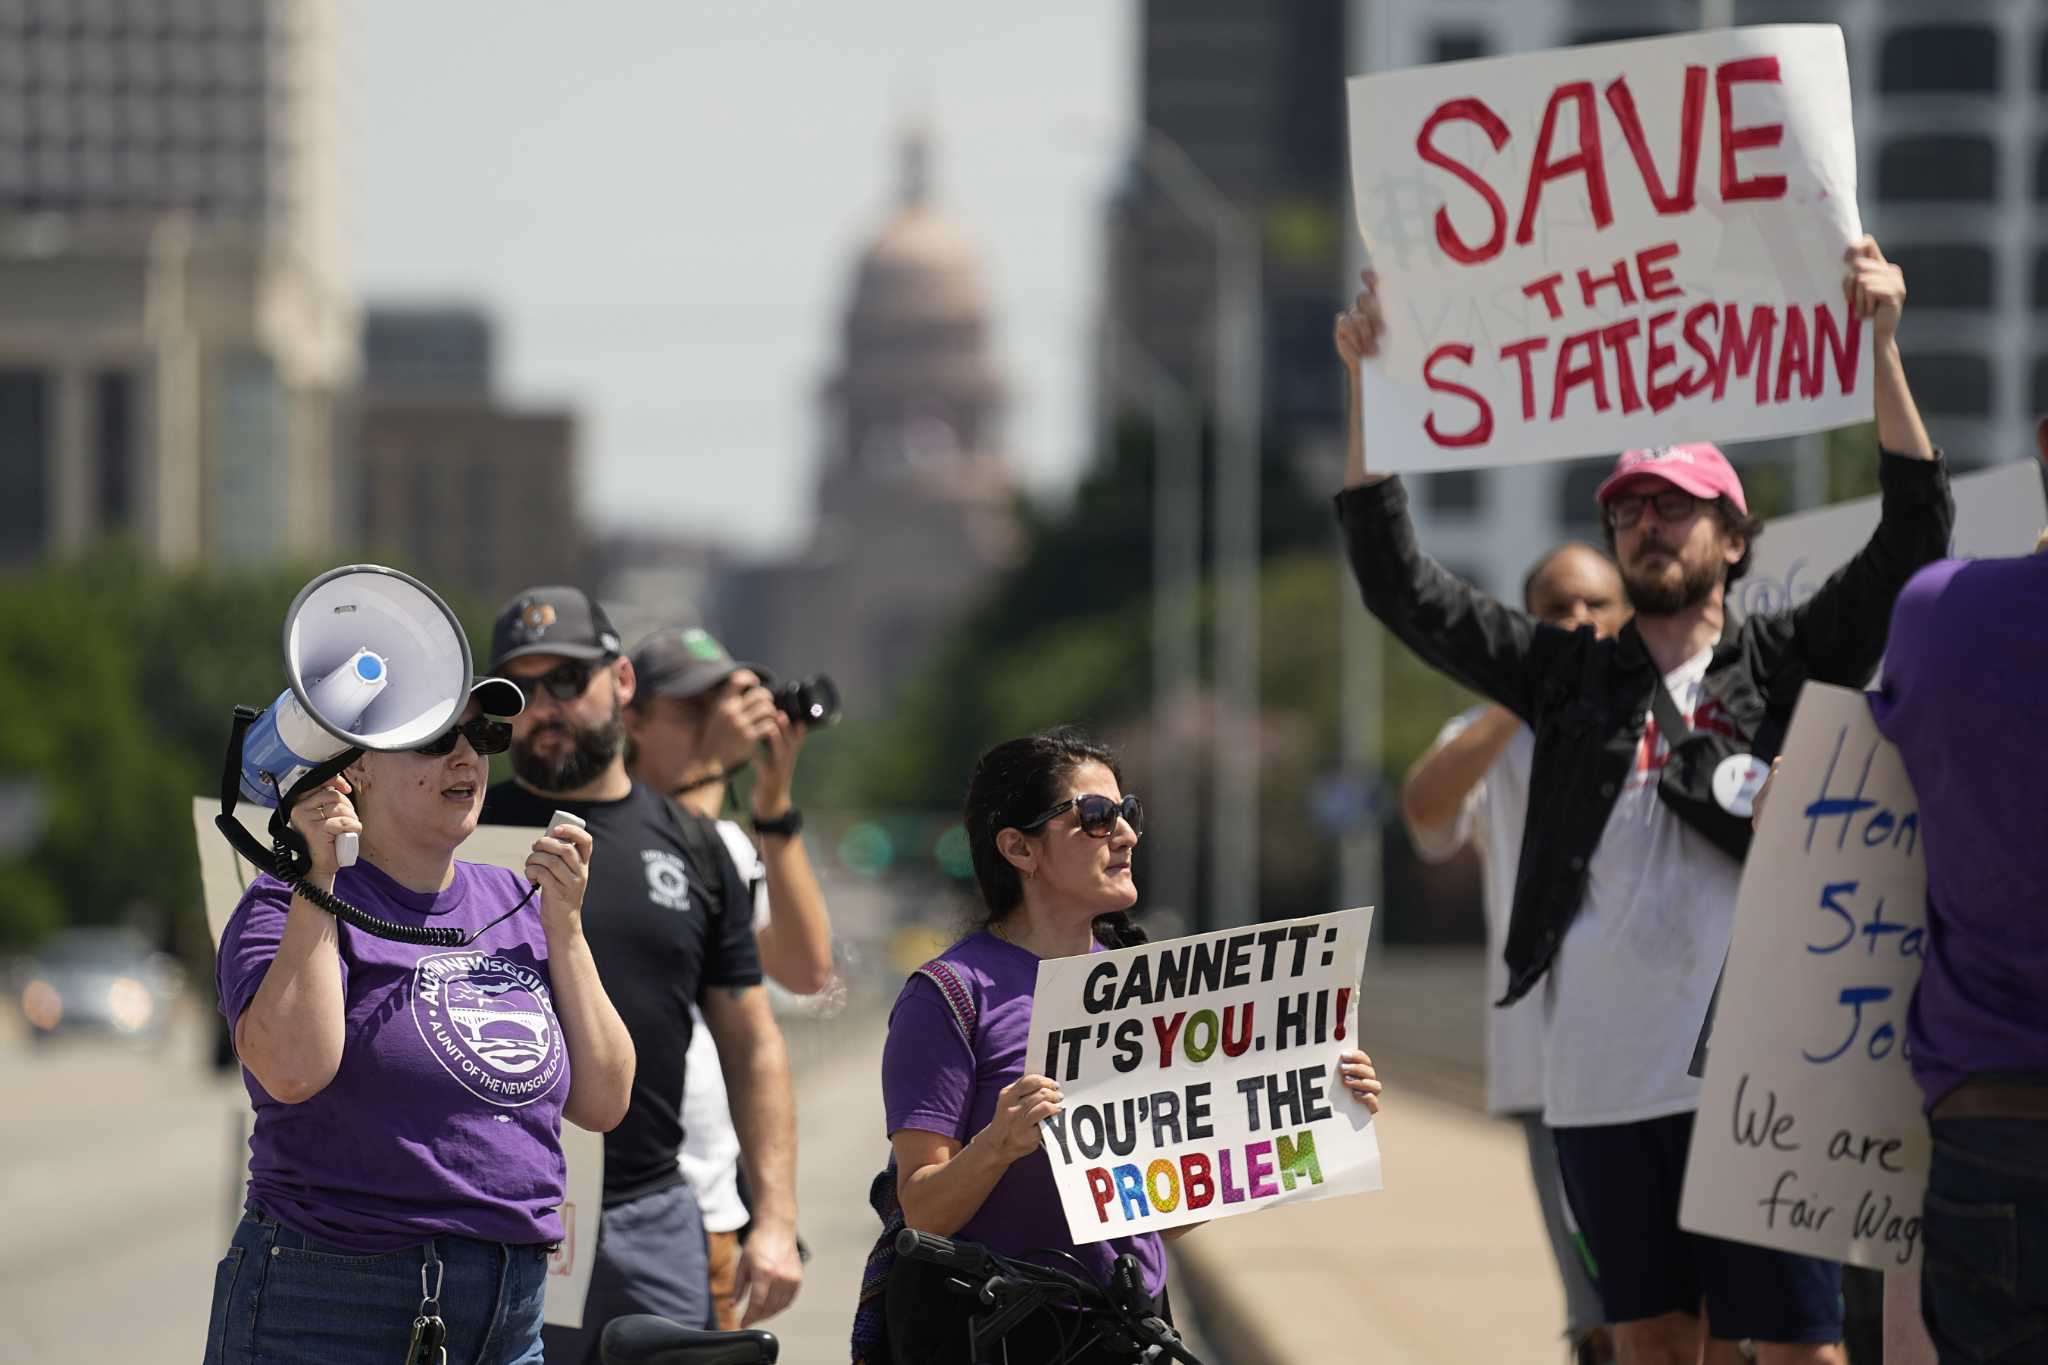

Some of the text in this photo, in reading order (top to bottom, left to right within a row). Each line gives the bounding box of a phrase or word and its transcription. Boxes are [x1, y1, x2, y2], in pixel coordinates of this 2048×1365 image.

[1416, 55, 1787, 265] SAVE
[1523, 242, 1683, 318] THE
[1423, 299, 1861, 449] STATESMAN
[1803, 725, 1919, 855] Hon
[1806, 882, 1928, 957] Sta
[1083, 924, 1338, 1014] GANNETT:
[429, 1022, 443, 1032] A
[436, 1030, 466, 1061] UNIT
[462, 1059, 481, 1076] OF
[480, 1071, 502, 1093] THE
[1045, 987, 1351, 1082] IT'S YOU. HI!
[1043, 1064, 1332, 1165] YOU'RE THE
[1731, 1073, 1904, 1173] We are
[1085, 1130, 1324, 1223] PROBLEM
[1759, 1170, 1924, 1265] fair Wag
